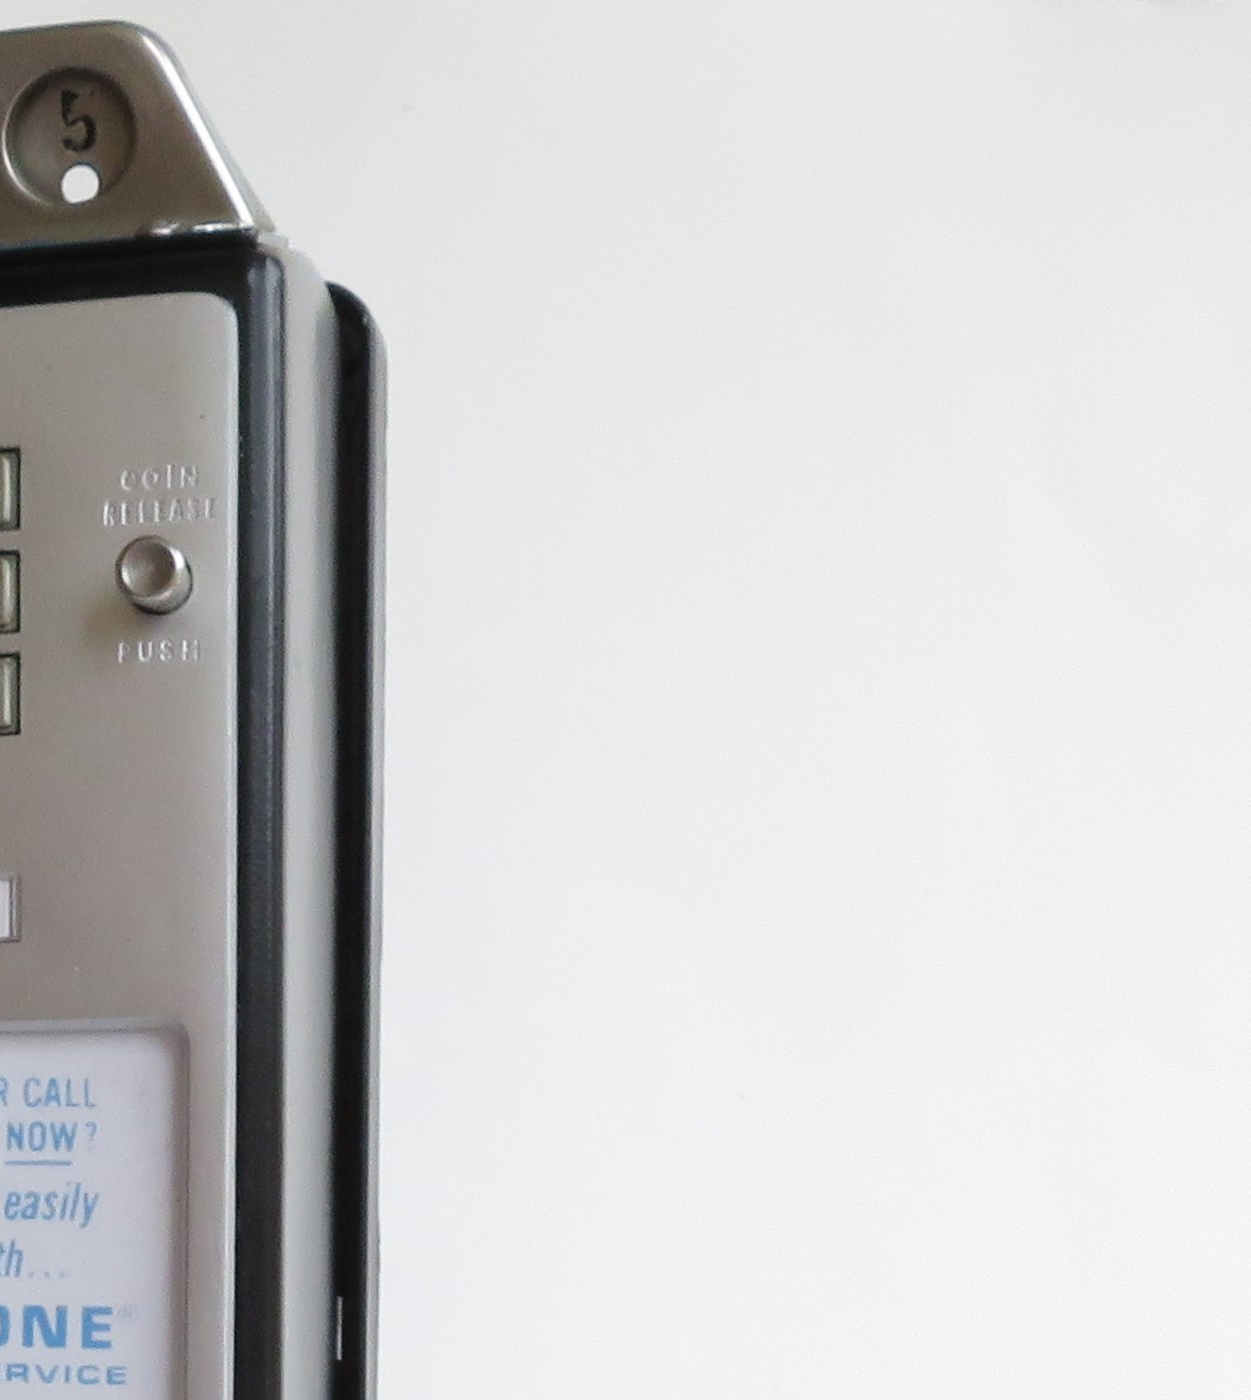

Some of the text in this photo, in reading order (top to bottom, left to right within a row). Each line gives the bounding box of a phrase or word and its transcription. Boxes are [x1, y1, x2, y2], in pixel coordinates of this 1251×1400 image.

[61, 88, 97, 152] 5
[120, 464, 198, 492] COIN
[102, 497, 215, 527] RELEASE
[117, 638, 200, 664] PUSH
[23, 1076, 98, 1108] CALL
[6, 1120, 98, 1153] NOW?
[3, 1181, 99, 1230] easily
